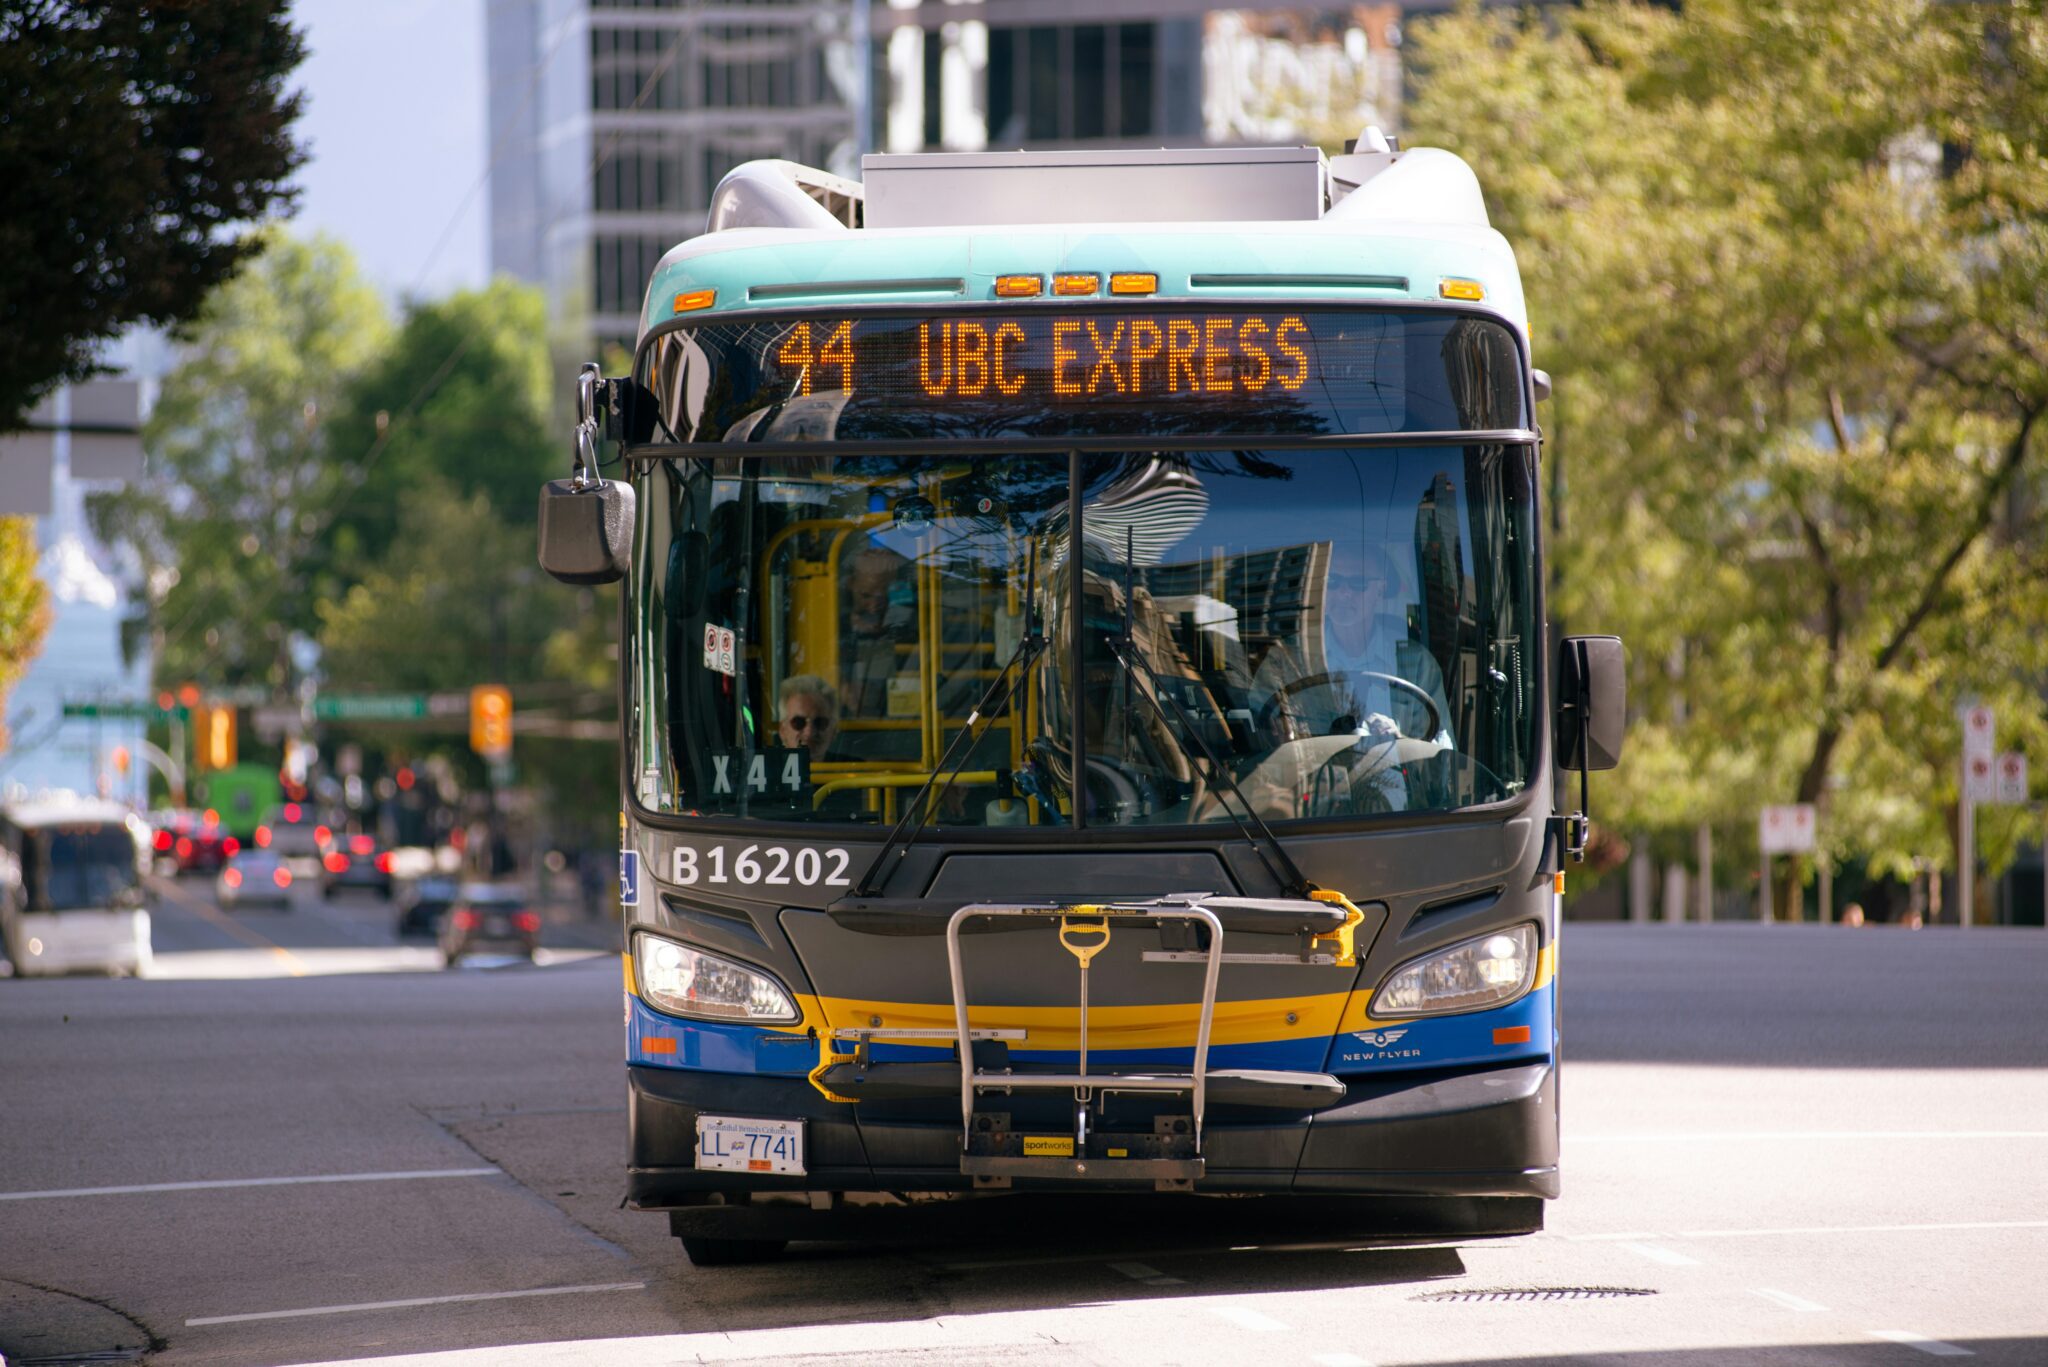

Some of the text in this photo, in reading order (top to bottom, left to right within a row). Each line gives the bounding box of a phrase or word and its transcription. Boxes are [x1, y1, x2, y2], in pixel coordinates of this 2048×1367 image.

[779, 317, 1308, 396] 44 UBC EXPRESS
[672, 844, 851, 886] B16202
[1343, 1049, 1421, 1061] NEW FLYER
[745, 1133, 796, 1161] 7741
[1024, 1141, 1073, 1150] sportworks
